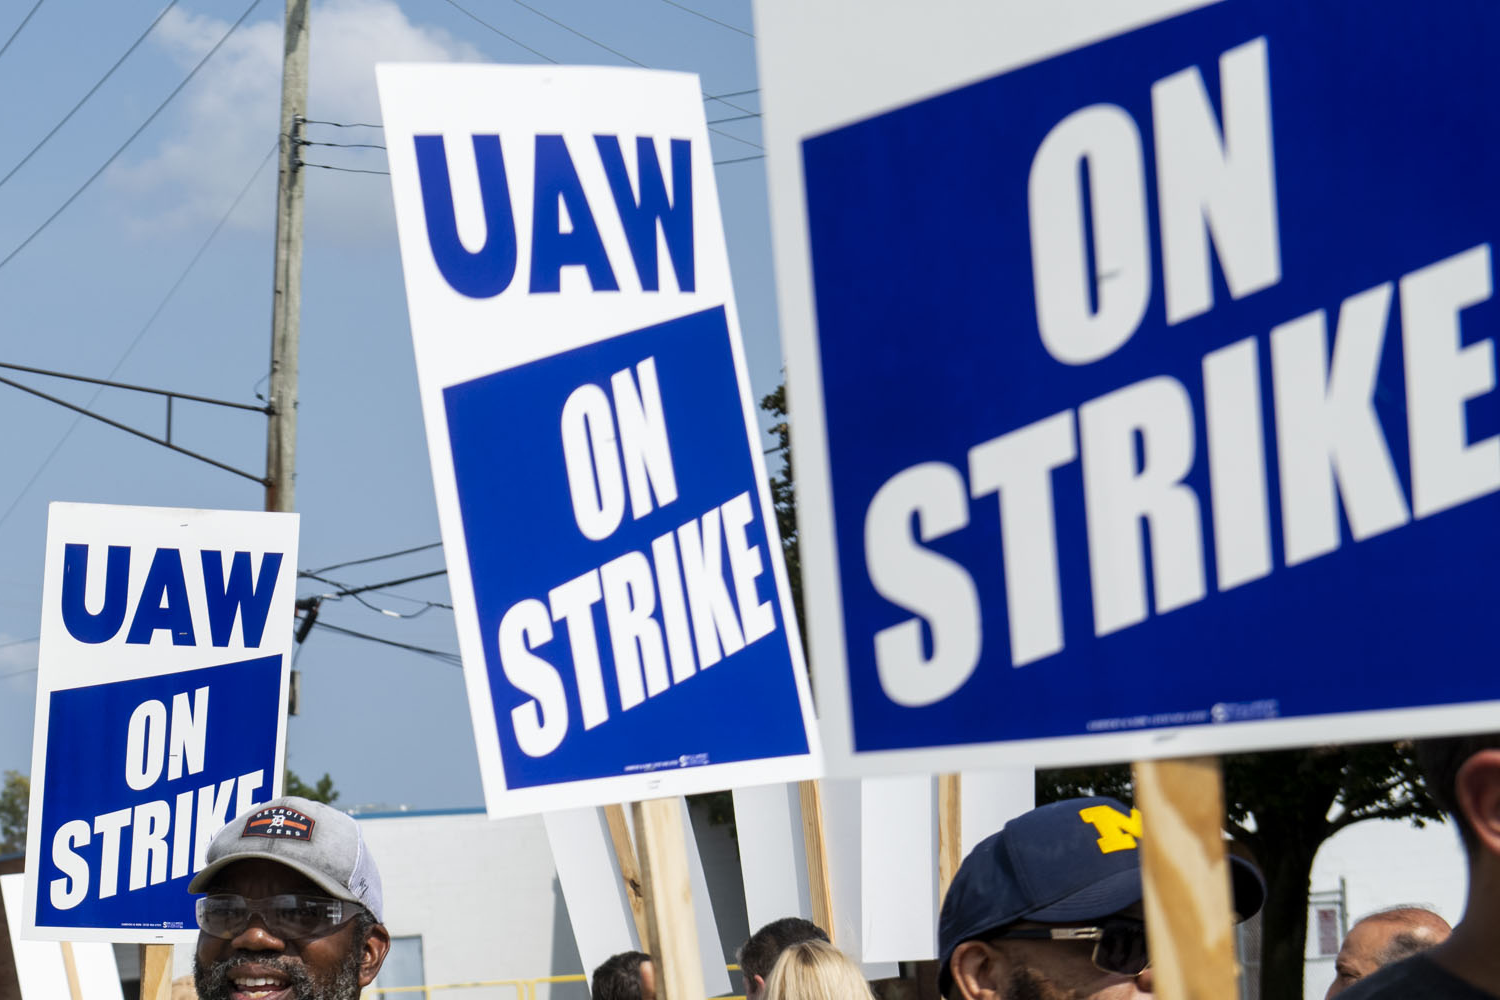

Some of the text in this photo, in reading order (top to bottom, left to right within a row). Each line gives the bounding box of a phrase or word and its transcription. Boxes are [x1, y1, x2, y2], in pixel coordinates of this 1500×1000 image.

[413, 133, 696, 299] UAW
[1027, 36, 1281, 366] ON
[560, 355, 678, 541] ON
[863, 243, 1500, 708] STRIKE
[61, 543, 283, 648] UAW
[498, 491, 777, 759] STRIKE
[125, 686, 210, 791] ON
[256, 809, 306, 821] DETROIT
